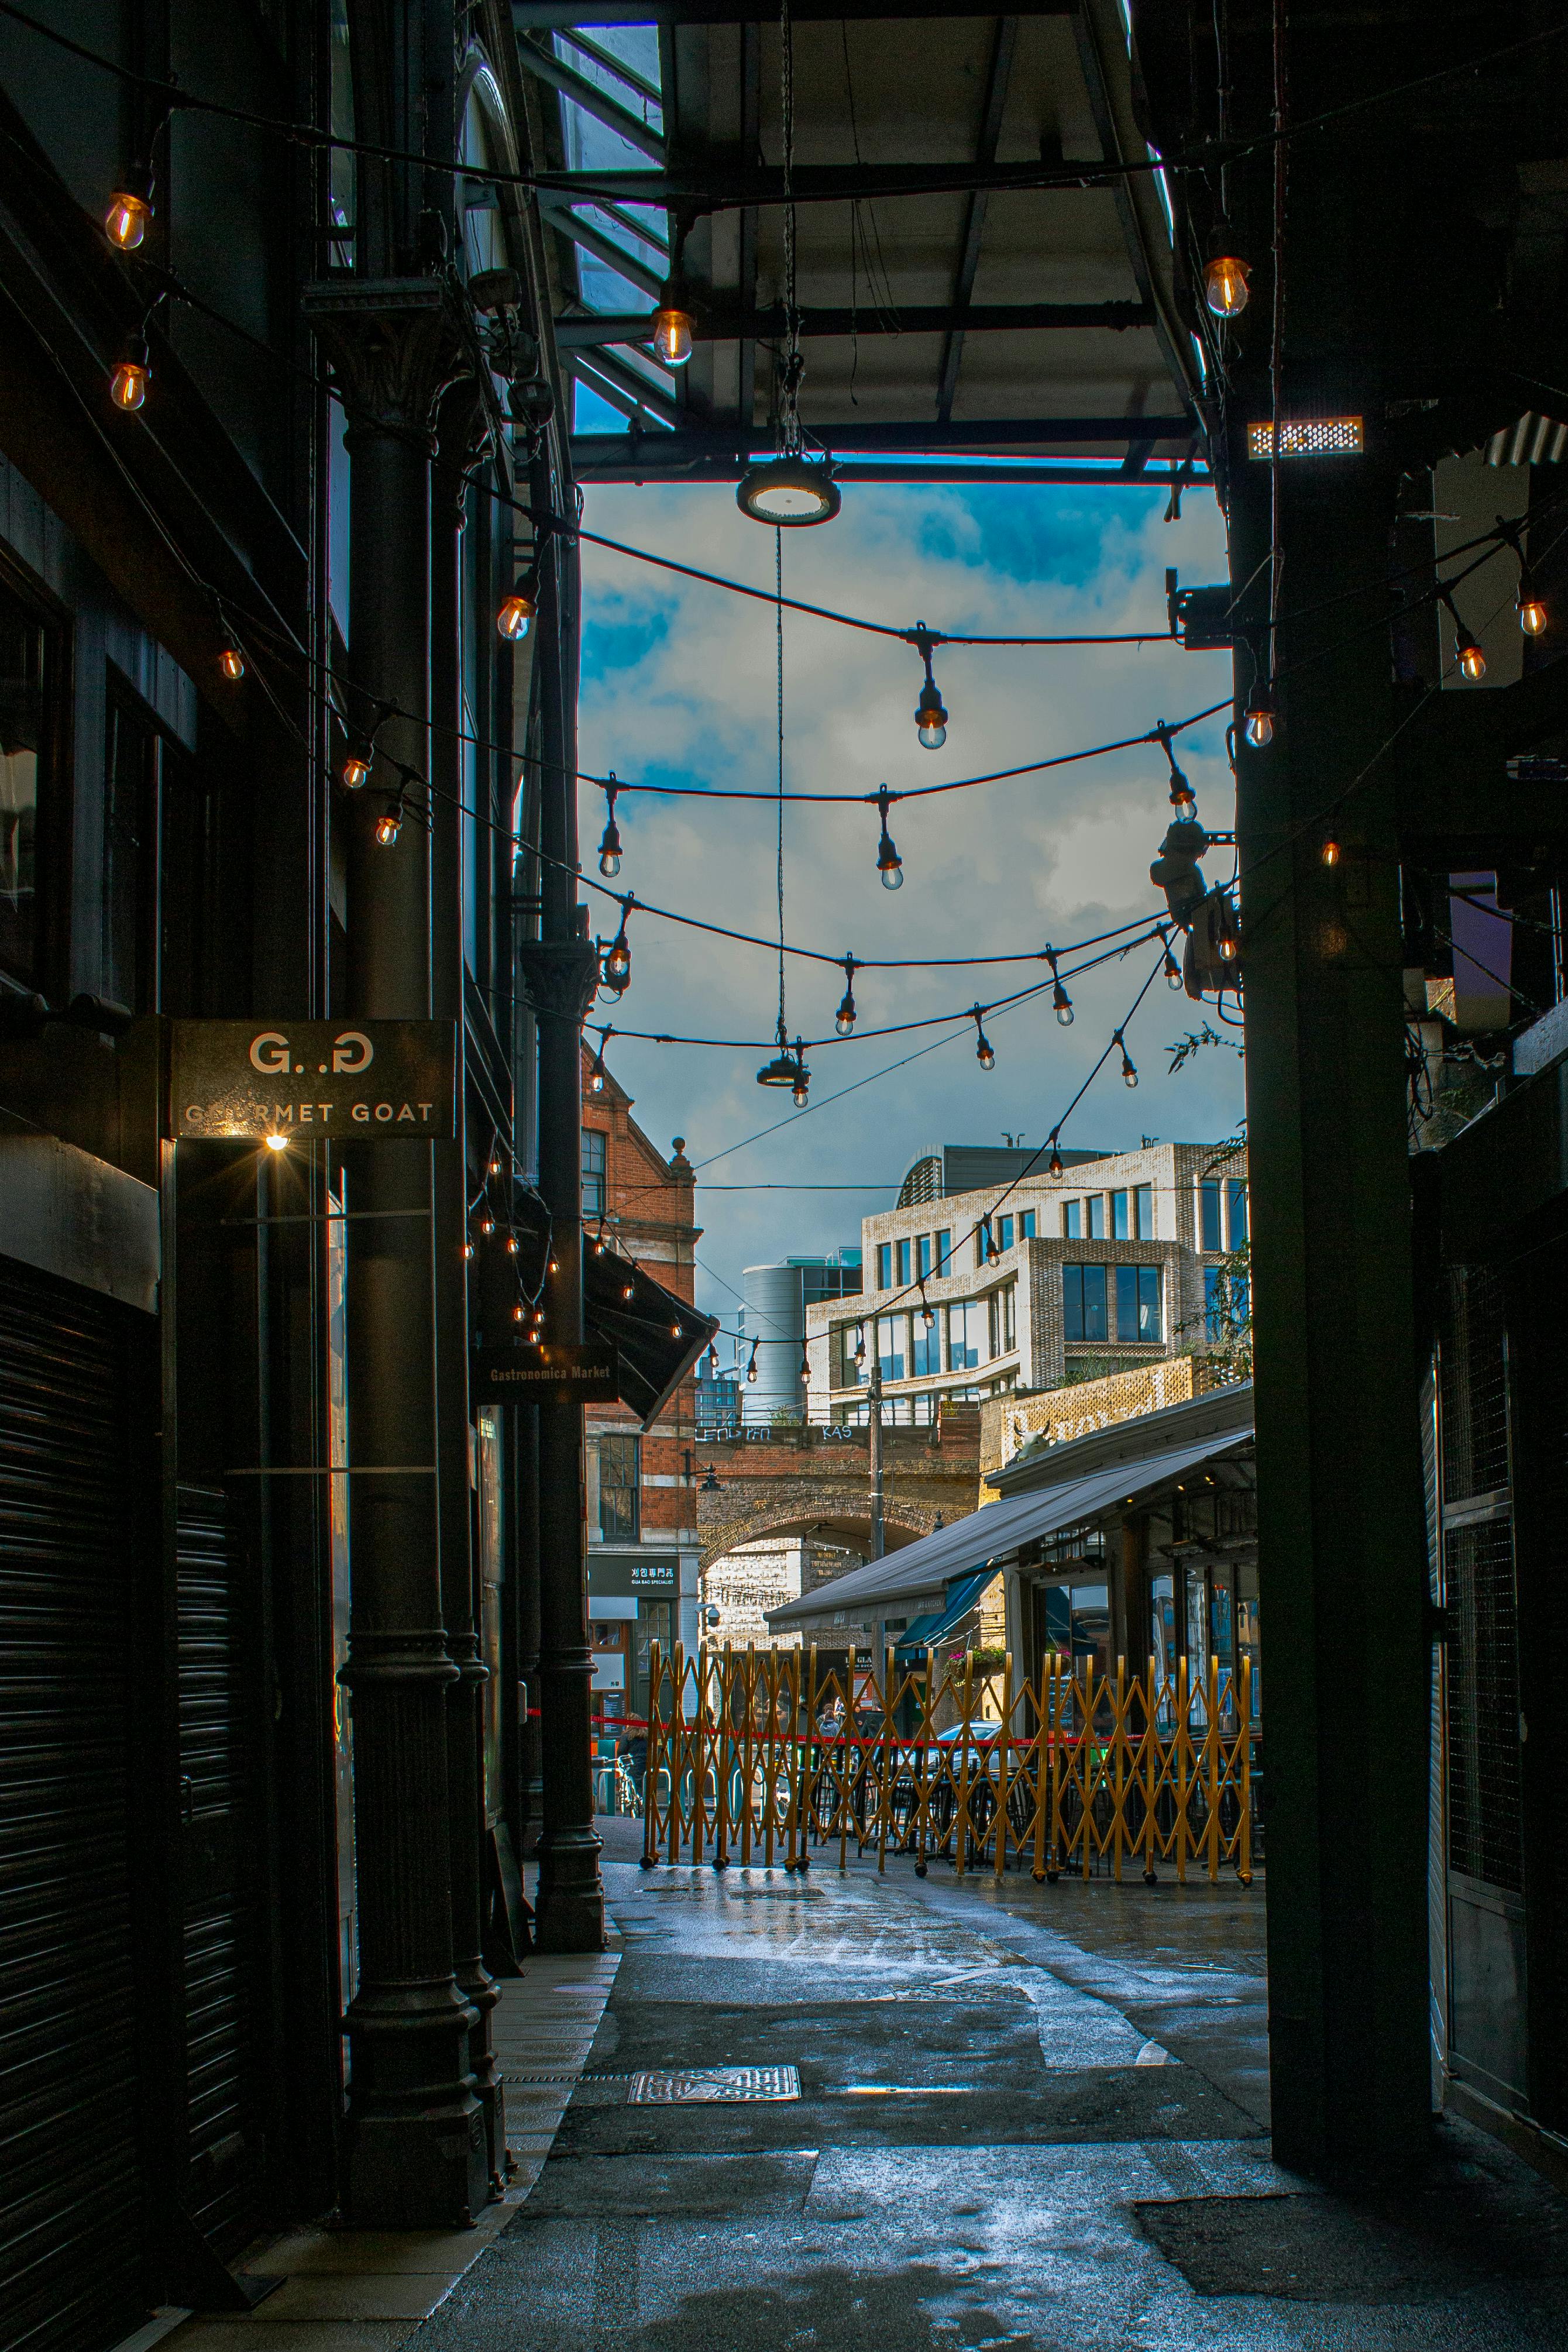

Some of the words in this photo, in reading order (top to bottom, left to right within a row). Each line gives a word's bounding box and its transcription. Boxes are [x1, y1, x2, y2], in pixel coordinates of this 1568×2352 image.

[352, 1103, 433, 1122] GOAT
[491, 1367, 566, 1381] Gastronomica
[572, 1366, 610, 1378] Market
[822, 1425, 852, 1440] KAS
